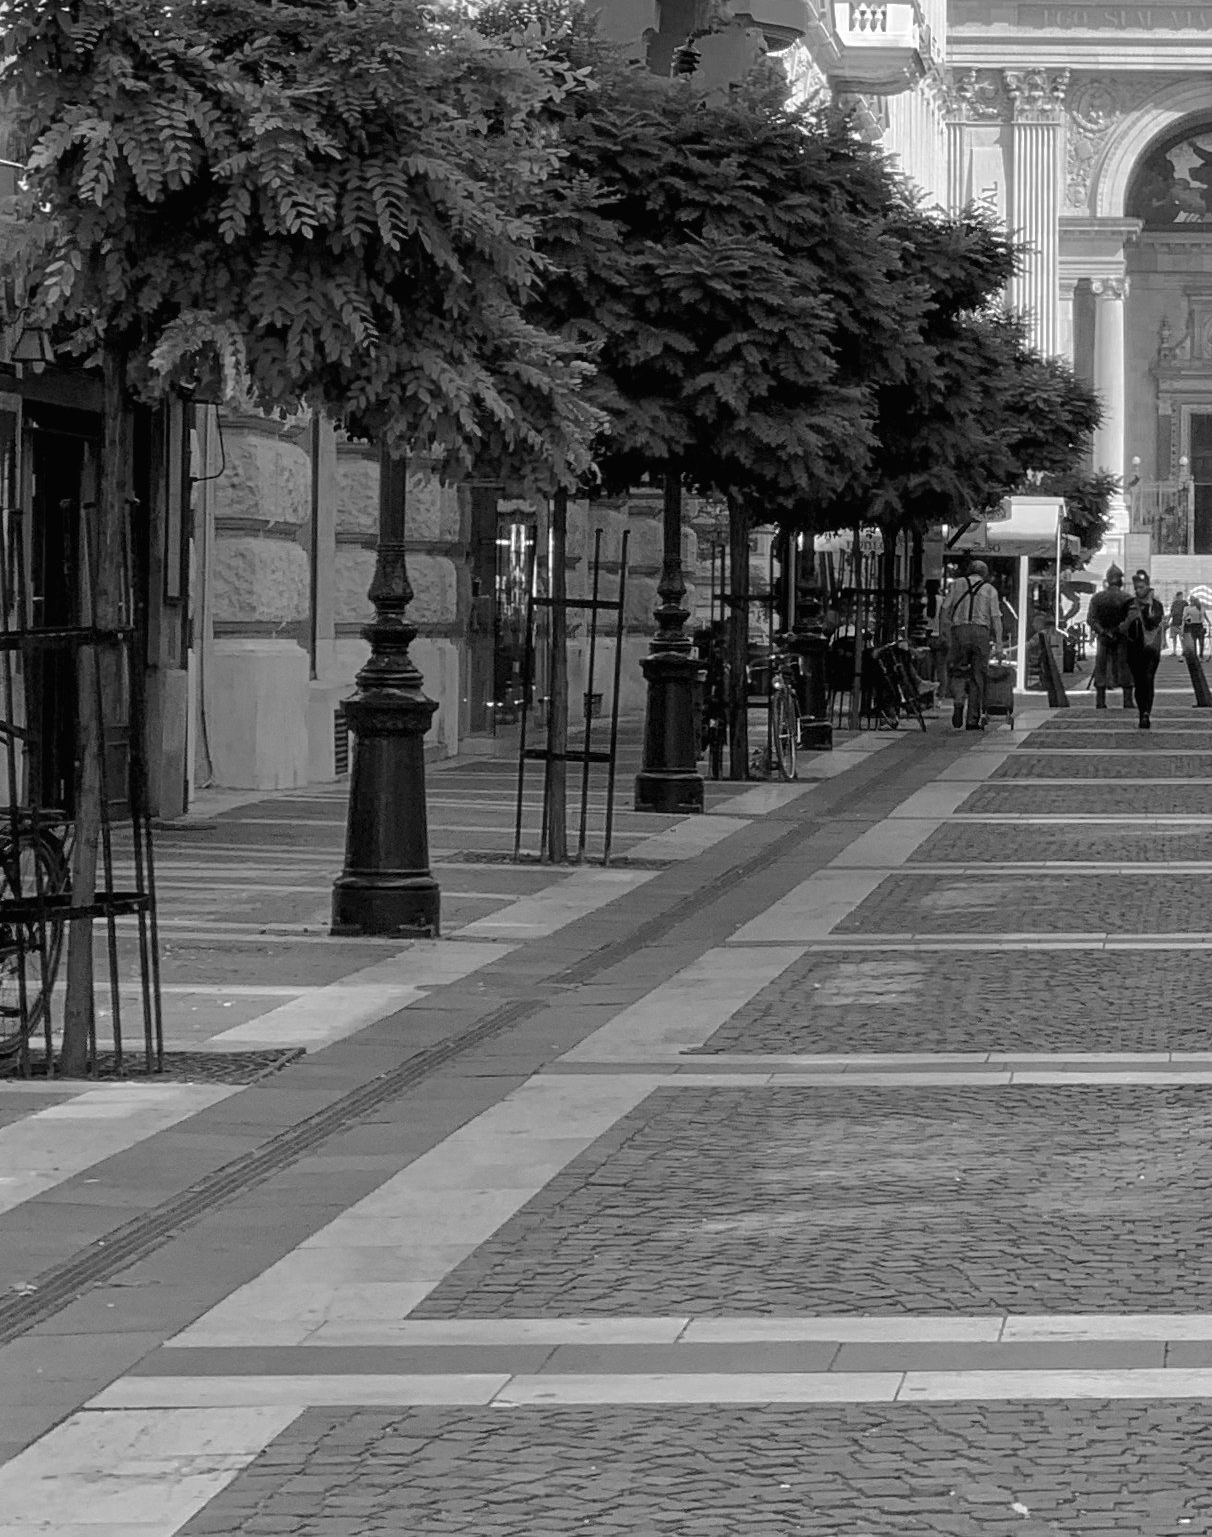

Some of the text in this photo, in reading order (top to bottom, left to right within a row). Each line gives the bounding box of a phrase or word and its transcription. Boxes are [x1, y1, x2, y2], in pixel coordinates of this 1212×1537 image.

[1042, 9, 1089, 26] EGO
[1103, 10, 1154, 26] SUM
[1170, 10, 1209, 27] VIA
